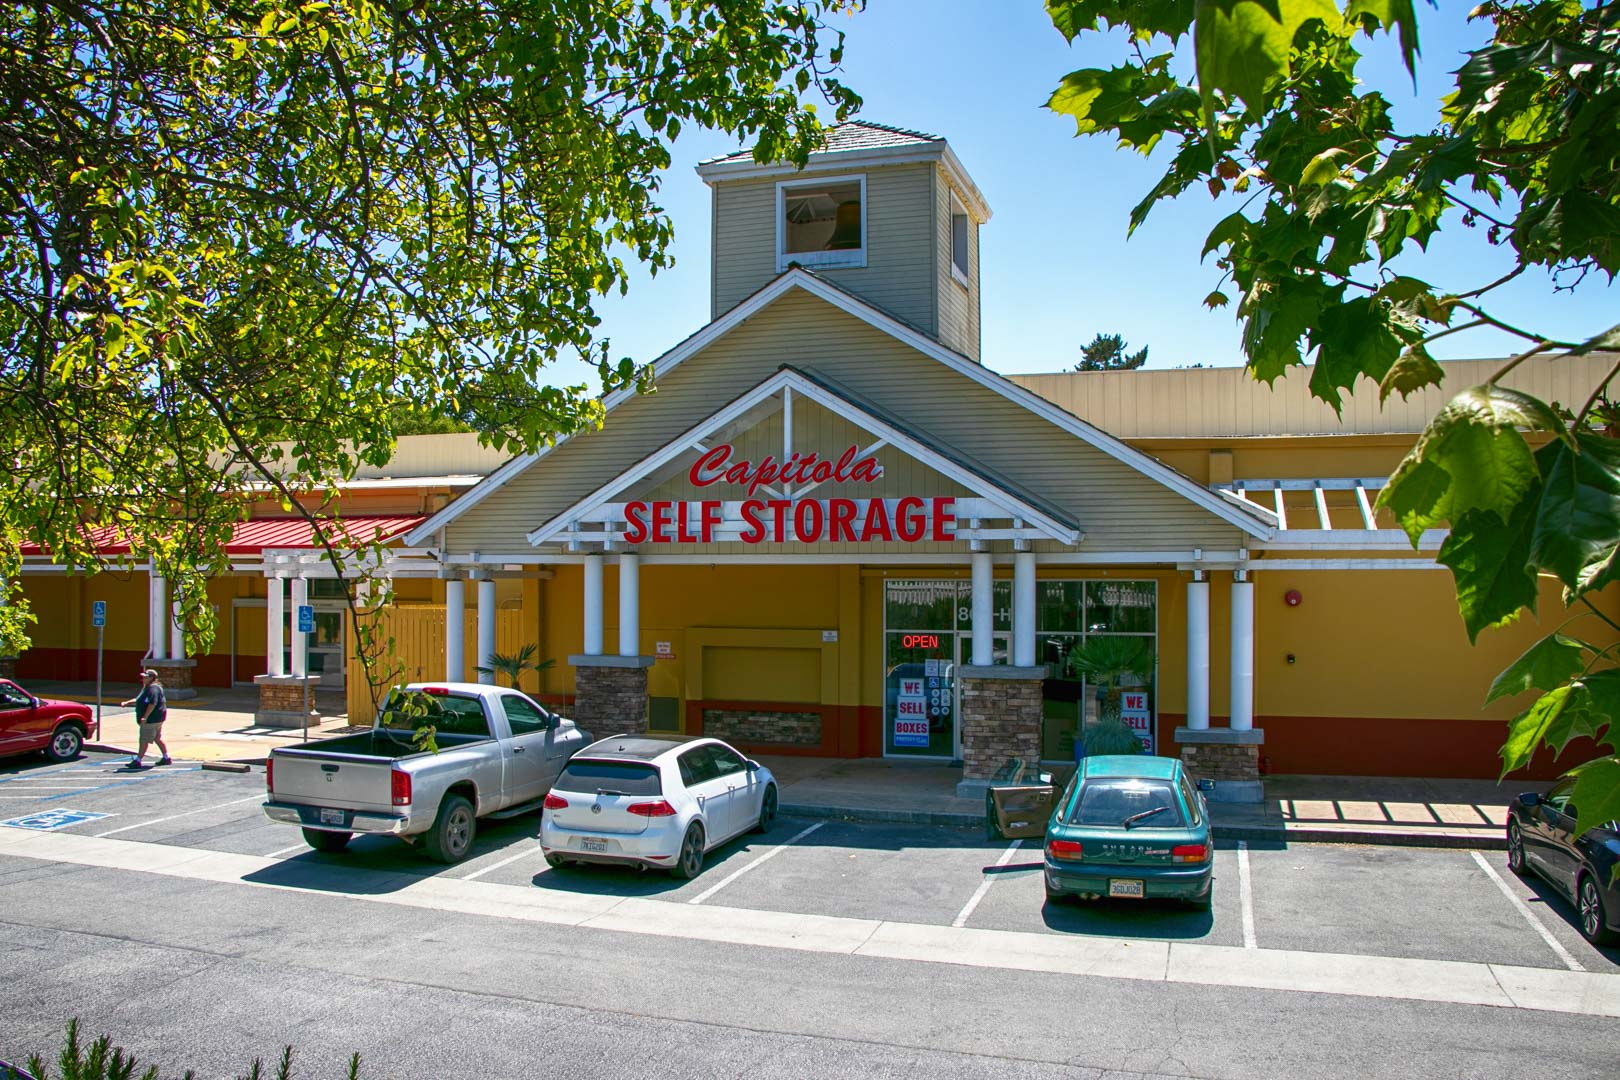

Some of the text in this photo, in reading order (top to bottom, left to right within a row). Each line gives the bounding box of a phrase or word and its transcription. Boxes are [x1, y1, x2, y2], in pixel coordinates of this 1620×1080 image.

[689, 445, 883, 496] Capitola
[623, 497, 956, 544] SELF STORAGE
[902, 635, 938, 648] OPEN
[904, 682, 920, 694] WE
[900, 702, 924, 714] SELL
[1126, 696, 1143, 708] WE
[896, 722, 927, 733] BOXES
[1121, 717, 1147, 729] SELL
